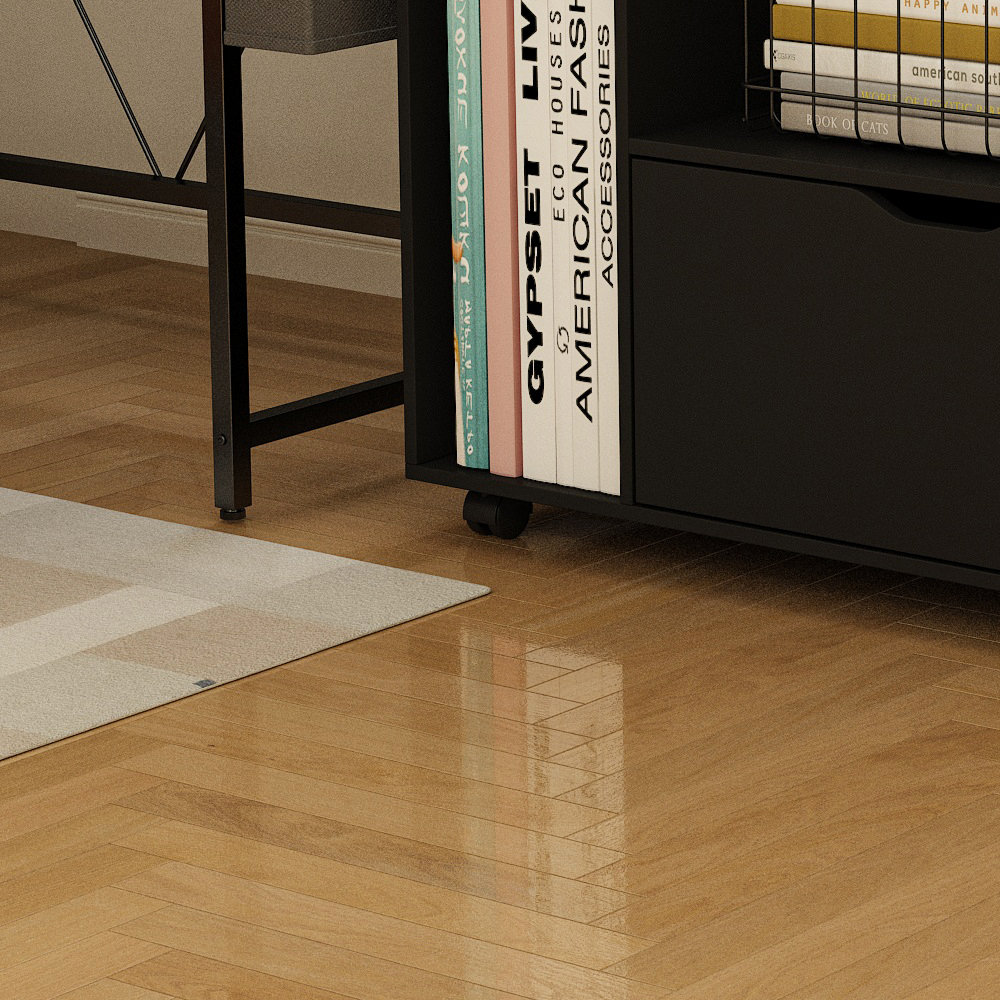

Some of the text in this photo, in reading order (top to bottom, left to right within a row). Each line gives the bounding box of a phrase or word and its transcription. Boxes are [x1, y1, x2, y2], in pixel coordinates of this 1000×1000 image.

[549, 10, 565, 222] ECO HOUSES
[597, 24, 614, 289] ACCESSORIES
[861, 121, 889, 135] CATS
[911, 65, 967, 82] american
[523, 147, 545, 405] GYPSET
[571, 138, 593, 423] AMERICAN
